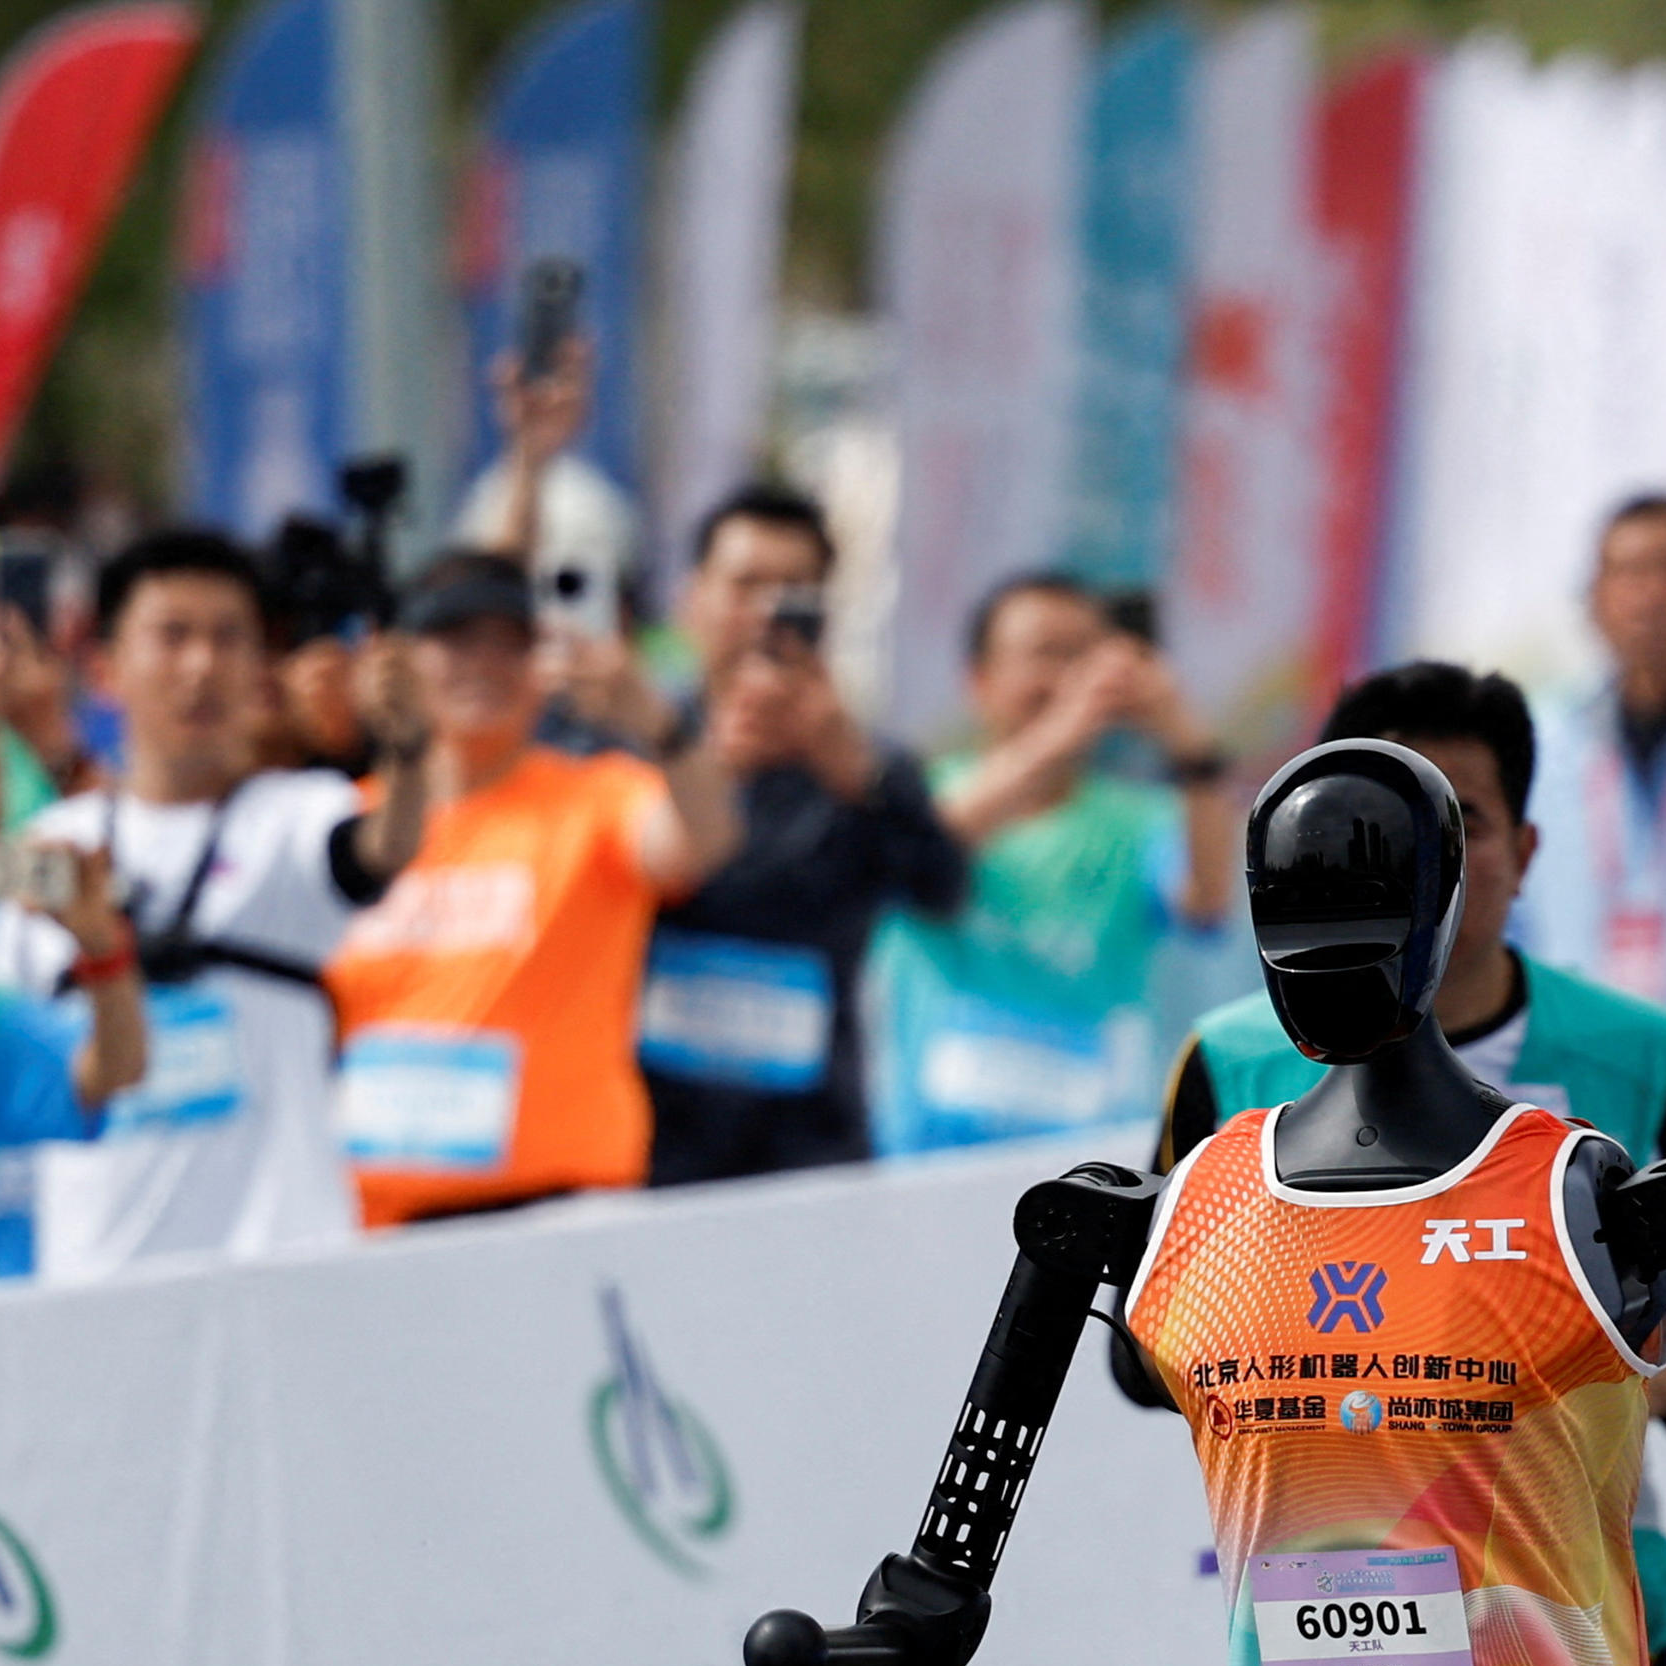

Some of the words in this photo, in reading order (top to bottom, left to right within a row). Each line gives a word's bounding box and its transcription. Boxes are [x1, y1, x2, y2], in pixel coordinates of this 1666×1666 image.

[1420, 1218, 1528, 1265] 天工
[1194, 1354, 1517, 1388] 北京人形机器人创新中心
[1388, 1397, 1513, 1422] 尚亦城集团
[1388, 1421, 1425, 1431] SHANG
[1476, 1424, 1513, 1433] GROUP
[1296, 1600, 1427, 1640] 60901
[1349, 1639, 1384, 1653] 天工队
